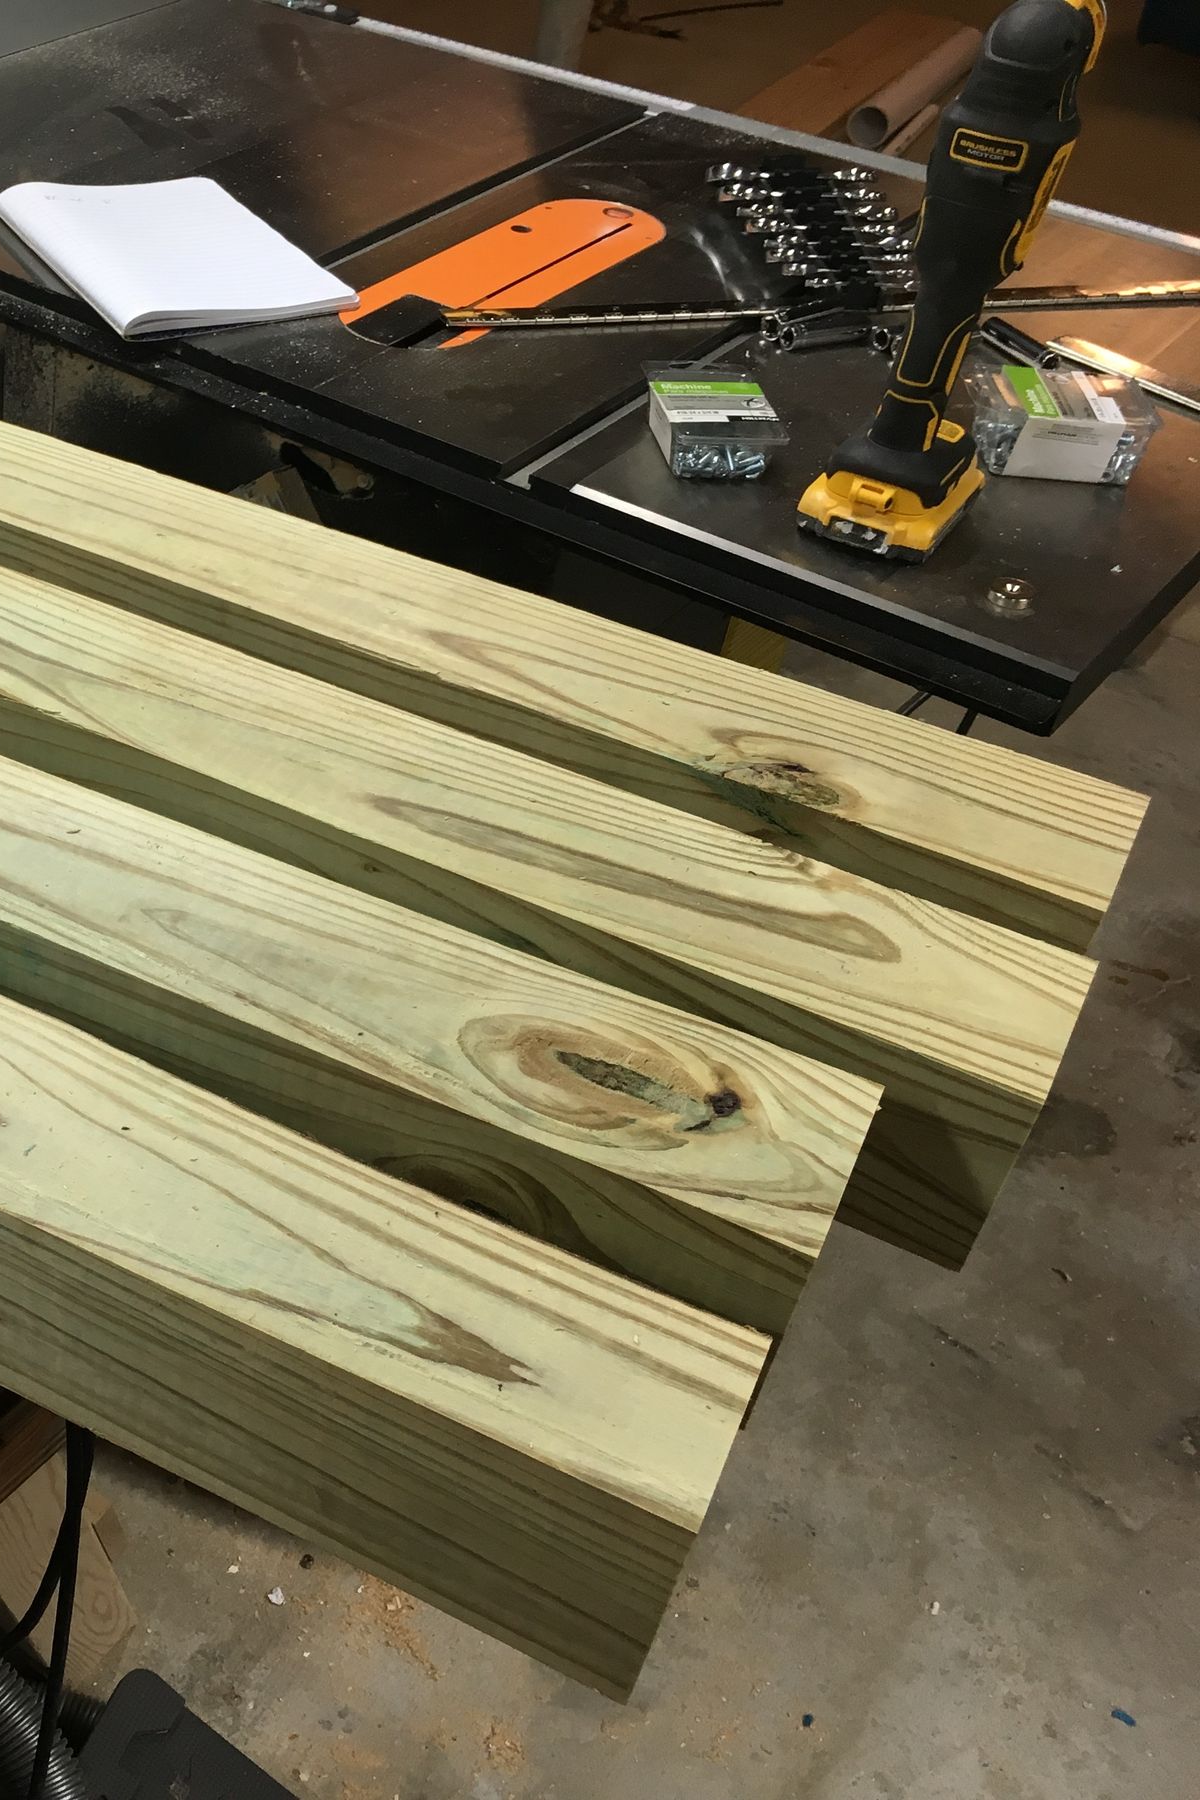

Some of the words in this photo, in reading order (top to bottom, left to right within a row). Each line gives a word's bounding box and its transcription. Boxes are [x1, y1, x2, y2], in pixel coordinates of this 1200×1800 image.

[960, 139, 1017, 157] BRUSHLESS
[967, 148, 1006, 160] MOTOR
[660, 383, 712, 391] Machine
